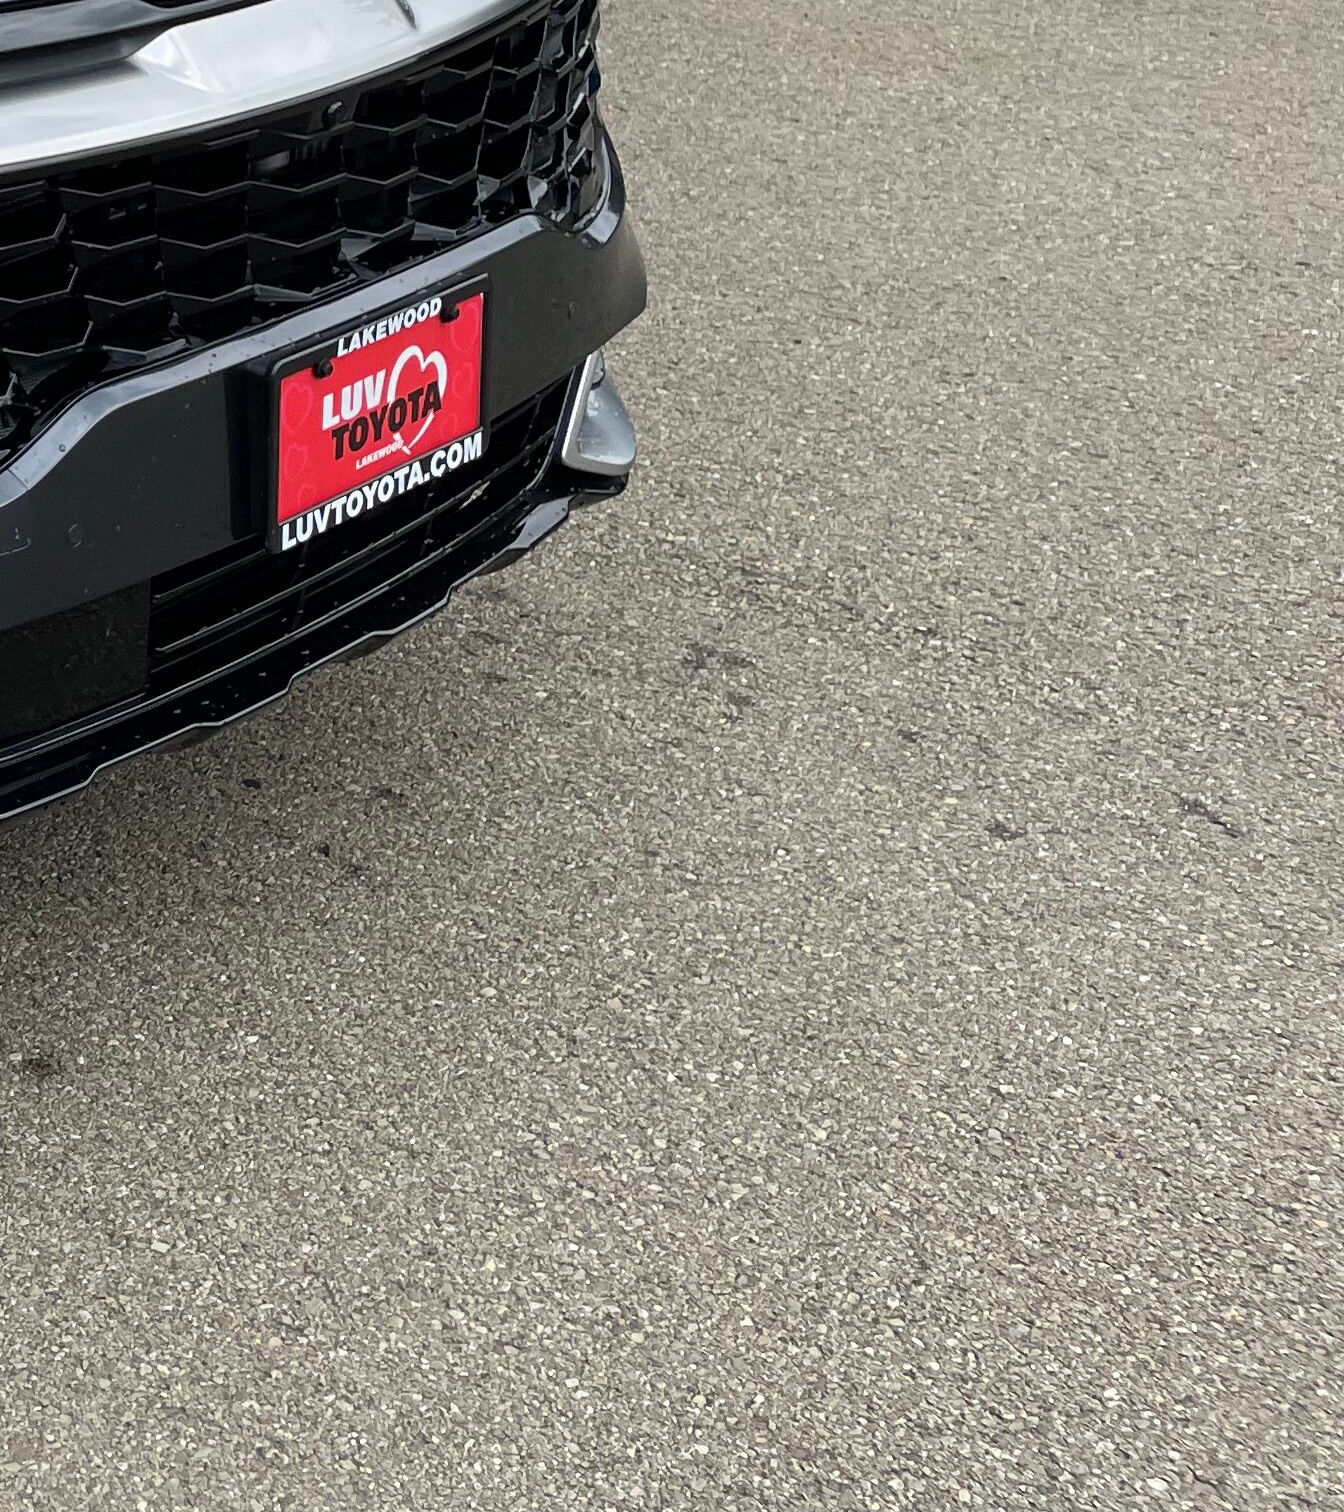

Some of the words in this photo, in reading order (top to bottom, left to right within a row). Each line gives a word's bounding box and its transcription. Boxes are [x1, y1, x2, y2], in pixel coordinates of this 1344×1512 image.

[336, 297, 442, 358] LAKEWOOD
[322, 368, 387, 431] LUV
[331, 381, 442, 460] TOYOTA
[281, 432, 482, 550] LUVTOYOTA.COM
